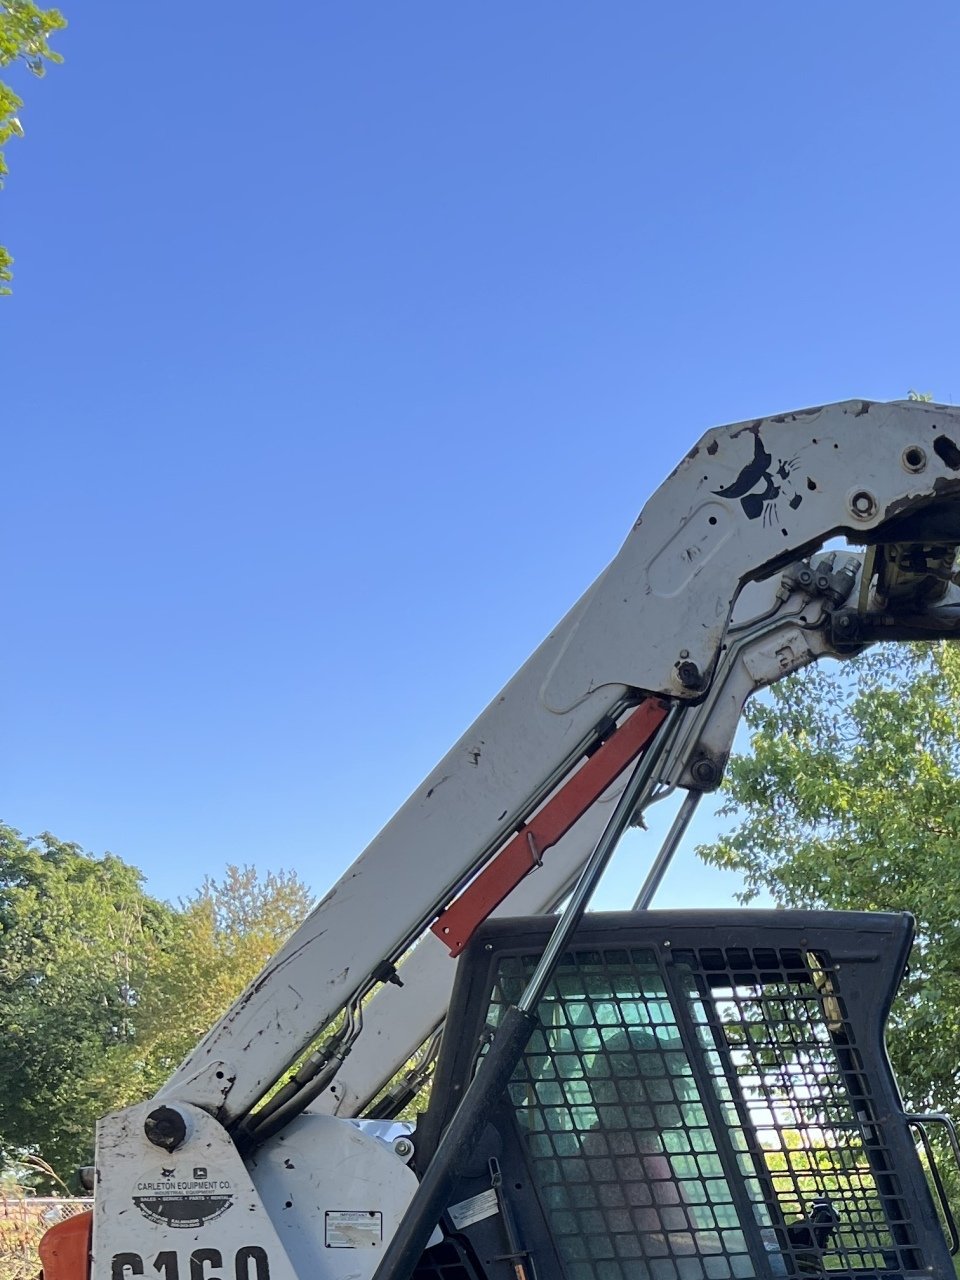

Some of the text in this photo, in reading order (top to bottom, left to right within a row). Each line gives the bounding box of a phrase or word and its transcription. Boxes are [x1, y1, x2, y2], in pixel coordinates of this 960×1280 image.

[137, 1181, 232, 1191] CARLETON EQUIPMENT CO.
